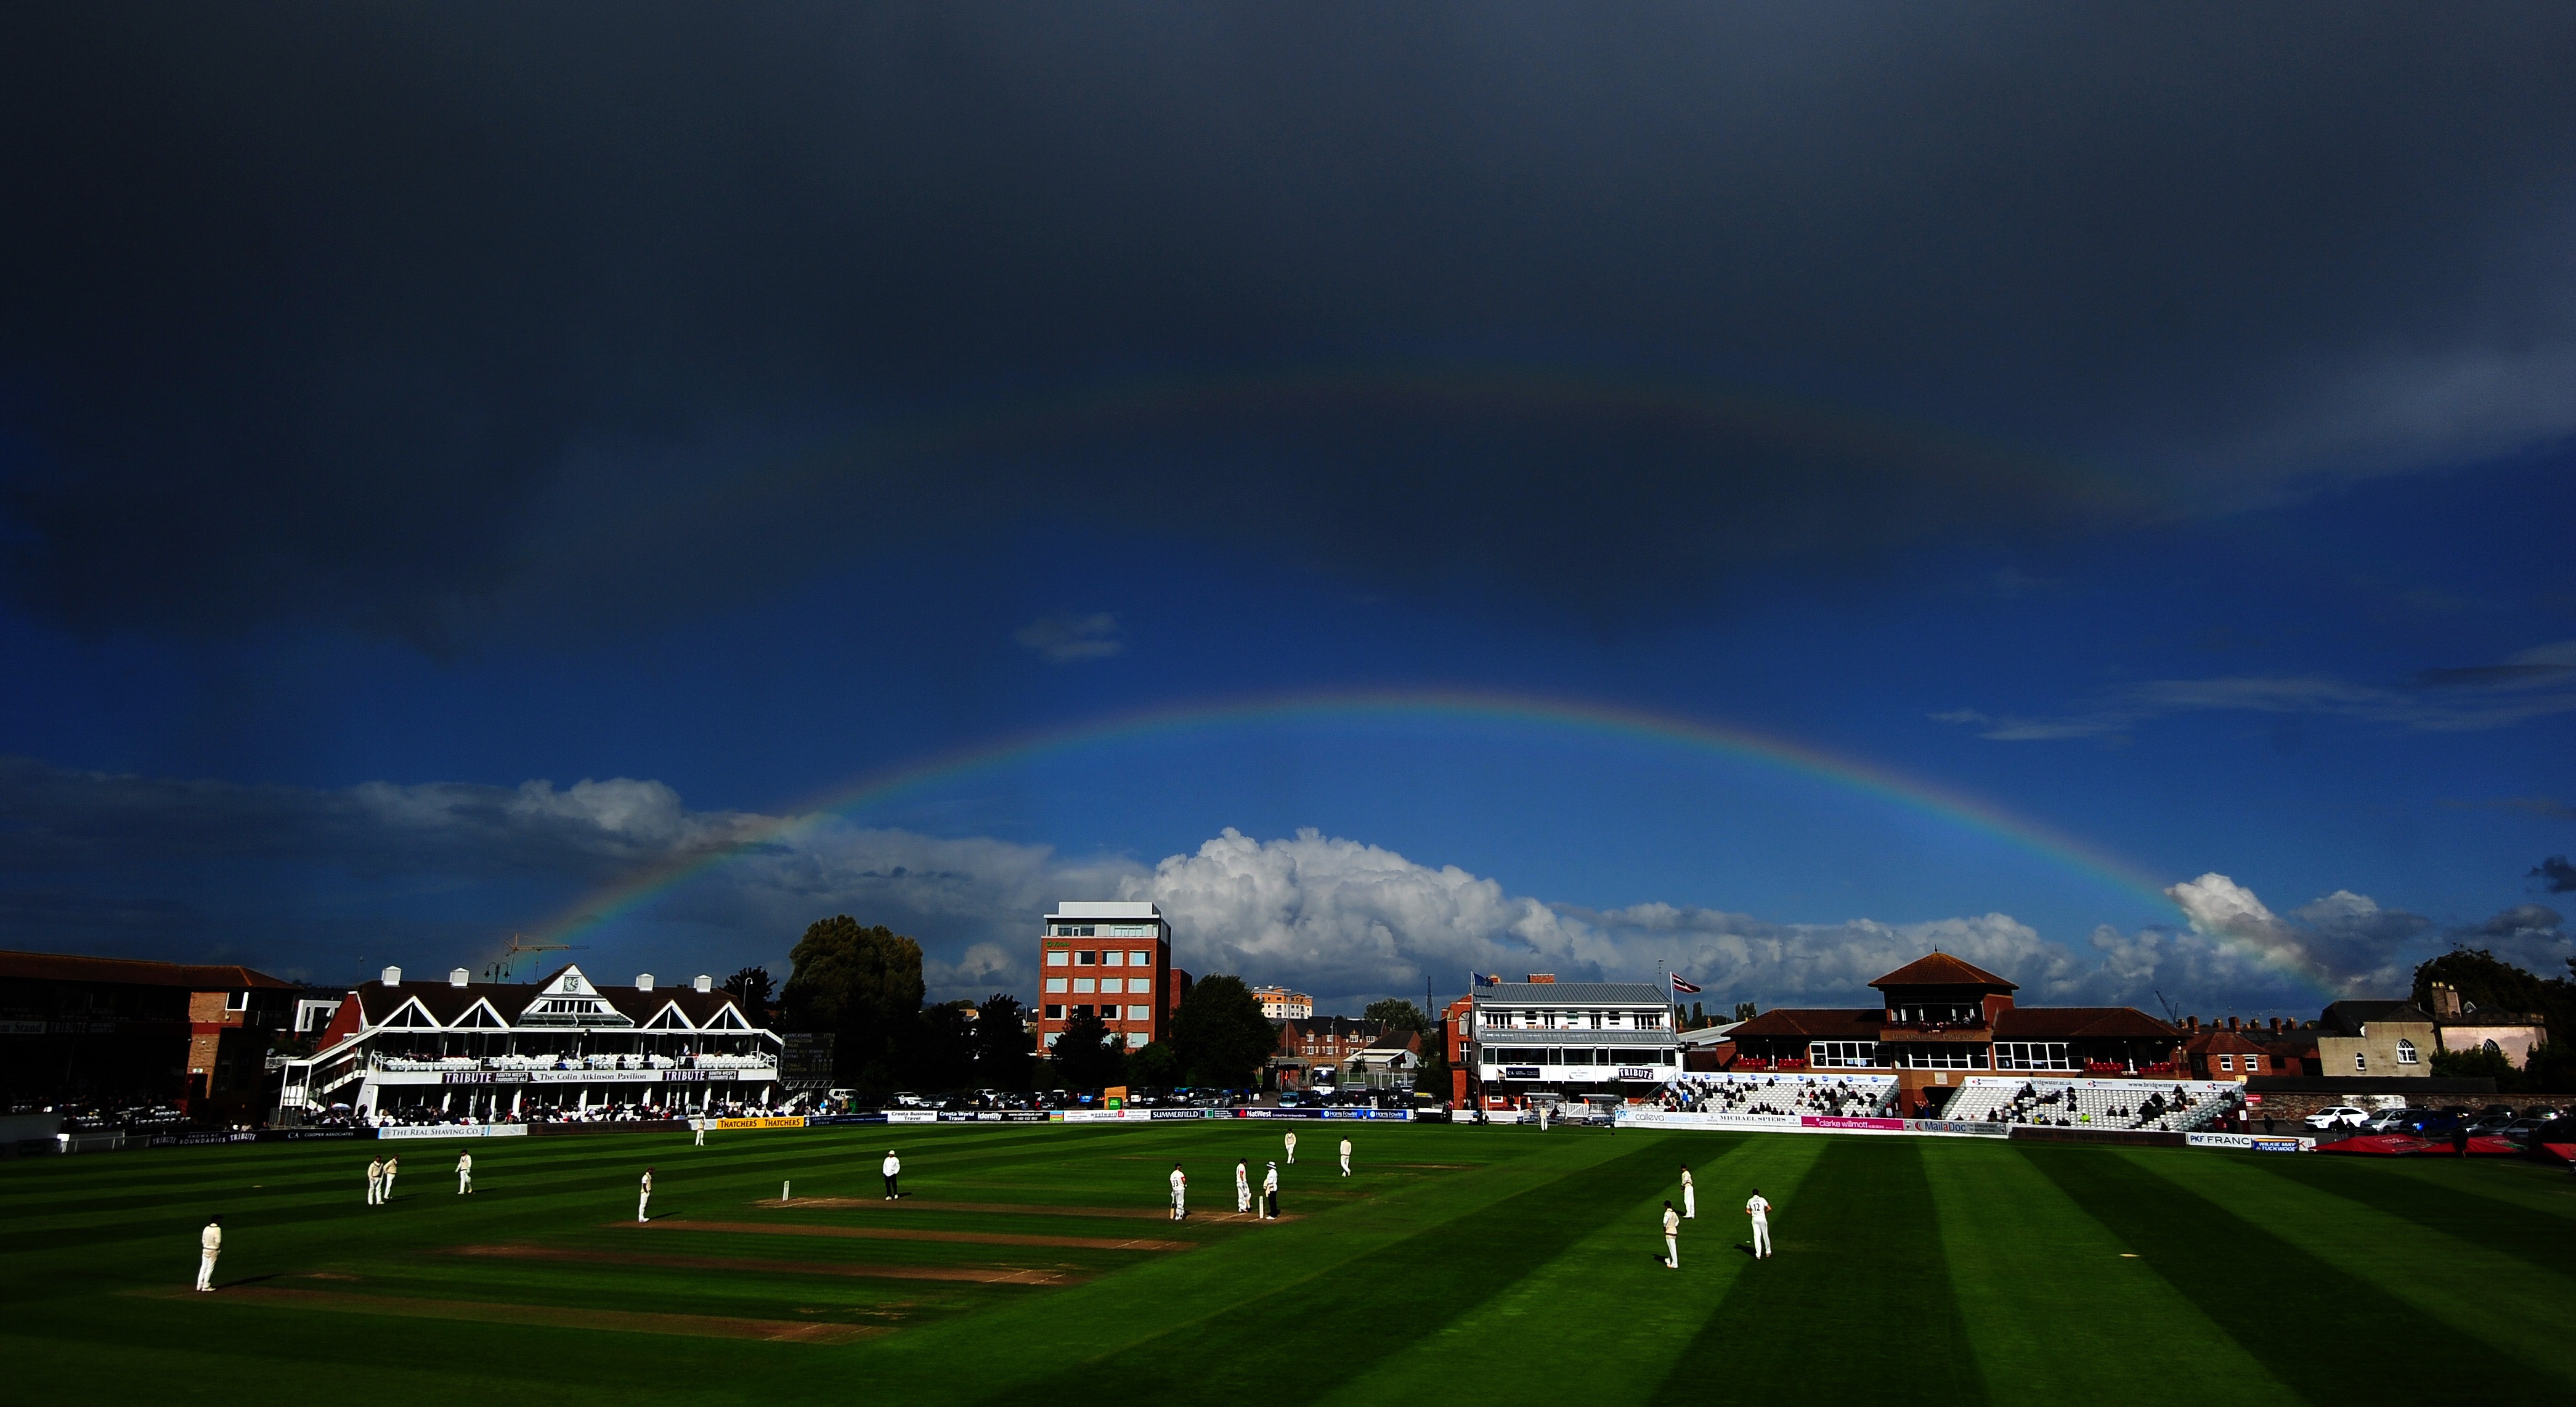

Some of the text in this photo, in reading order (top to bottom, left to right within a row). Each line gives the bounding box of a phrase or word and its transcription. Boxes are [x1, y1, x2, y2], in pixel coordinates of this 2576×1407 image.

[15, 1022, 43, 1032] Stand
[49, 1022, 87, 1033] TRIBUTE
[445, 1072, 492, 1083] TRIBUTE
[665, 1071, 705, 1080] TRIBUTE
[1619, 1068, 1653, 1079] TRIBUTE
[1635, 1113, 1665, 1121] calleva
[720, 1119, 757, 1128] THATCHERS
[765, 1118, 800, 1127] THATCHERS
[1819, 1119, 1841, 1127] clarke
[1842, 1120, 1868, 1128] willmott
[1925, 1121, 1966, 1132] MailaDoc
[431, 1127, 464, 1135] SHAVING
[541, 1125, 571, 1133] THANK
[153, 1136, 177, 1145] TRIBUTE
[179, 1137, 226, 1145] BOUNDARIES
[230, 1133, 257, 1141] TRIBUTE
[1753, 1203, 1760, 1211] 12
